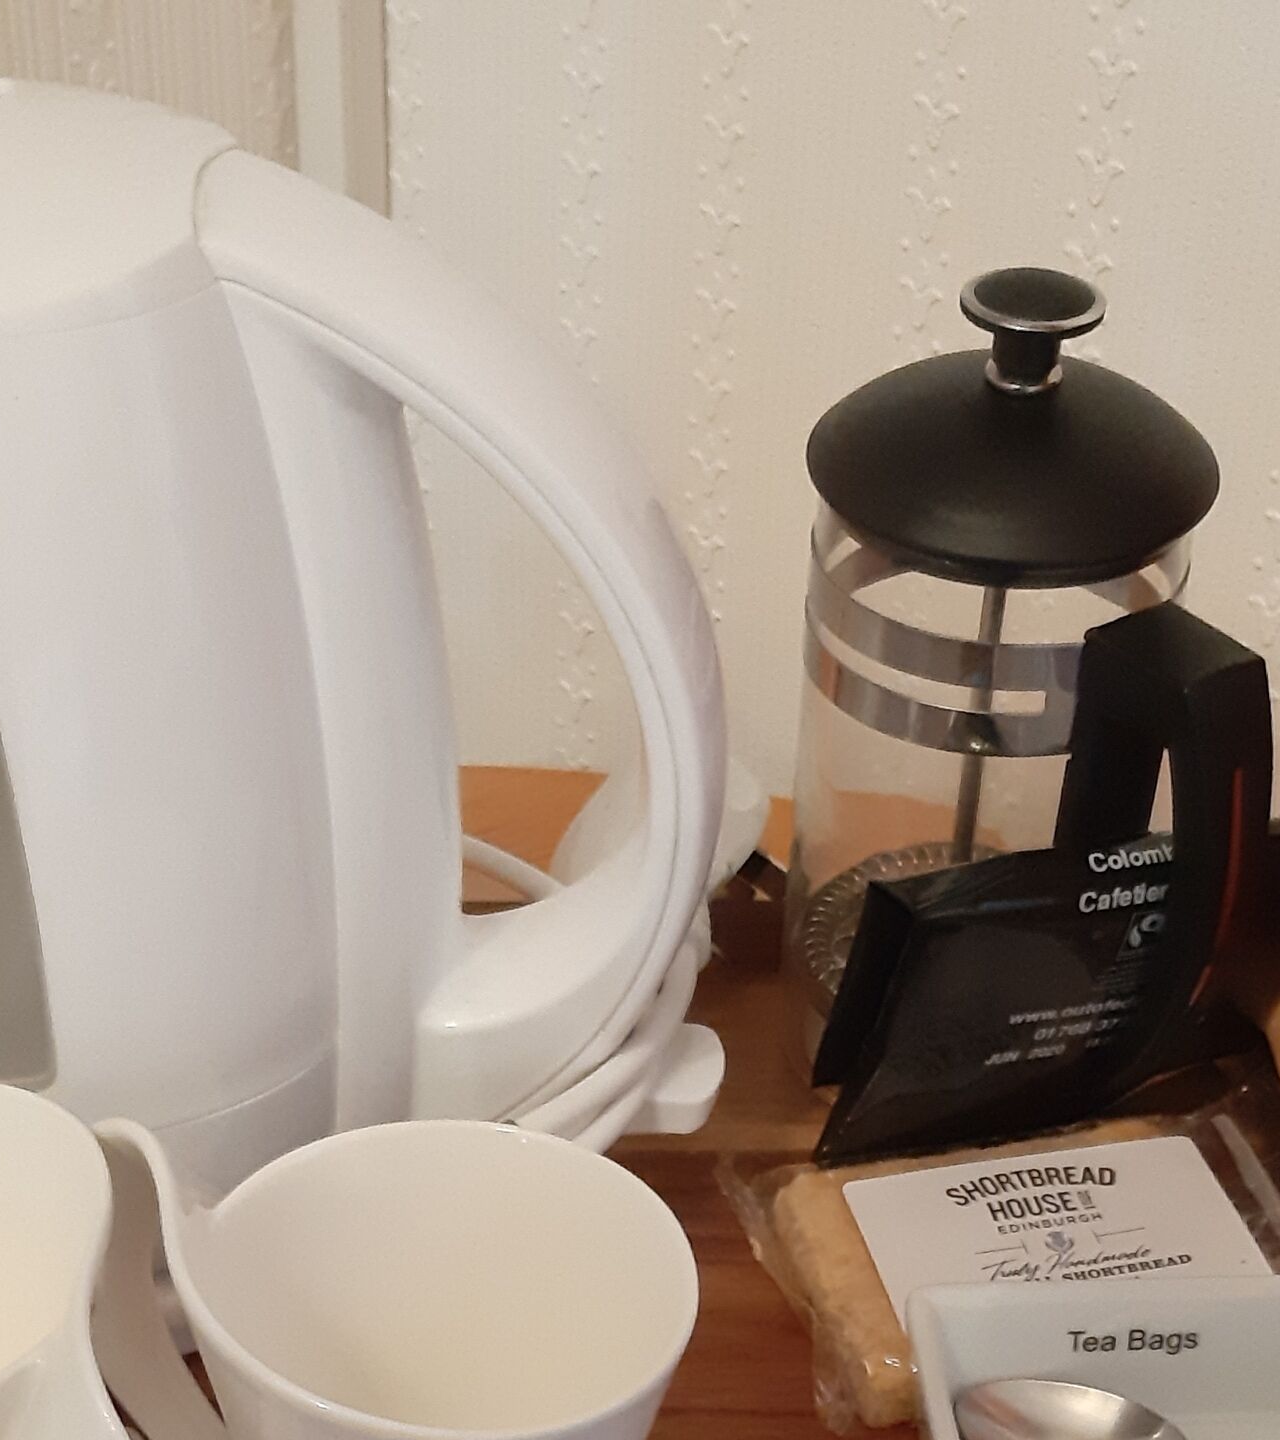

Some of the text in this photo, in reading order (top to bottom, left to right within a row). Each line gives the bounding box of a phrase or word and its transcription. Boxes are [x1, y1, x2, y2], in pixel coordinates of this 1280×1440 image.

[945, 1166, 1116, 1206] SHORTBREAD
[986, 1191, 1078, 1221] HOUSE
[997, 1212, 1103, 1235] EDINBURGH
[1044, 1244, 1152, 1275] Handmade
[1062, 1253, 1193, 1280] SHORTBREAD
[1067, 1329, 1199, 1355] Tea Bags
